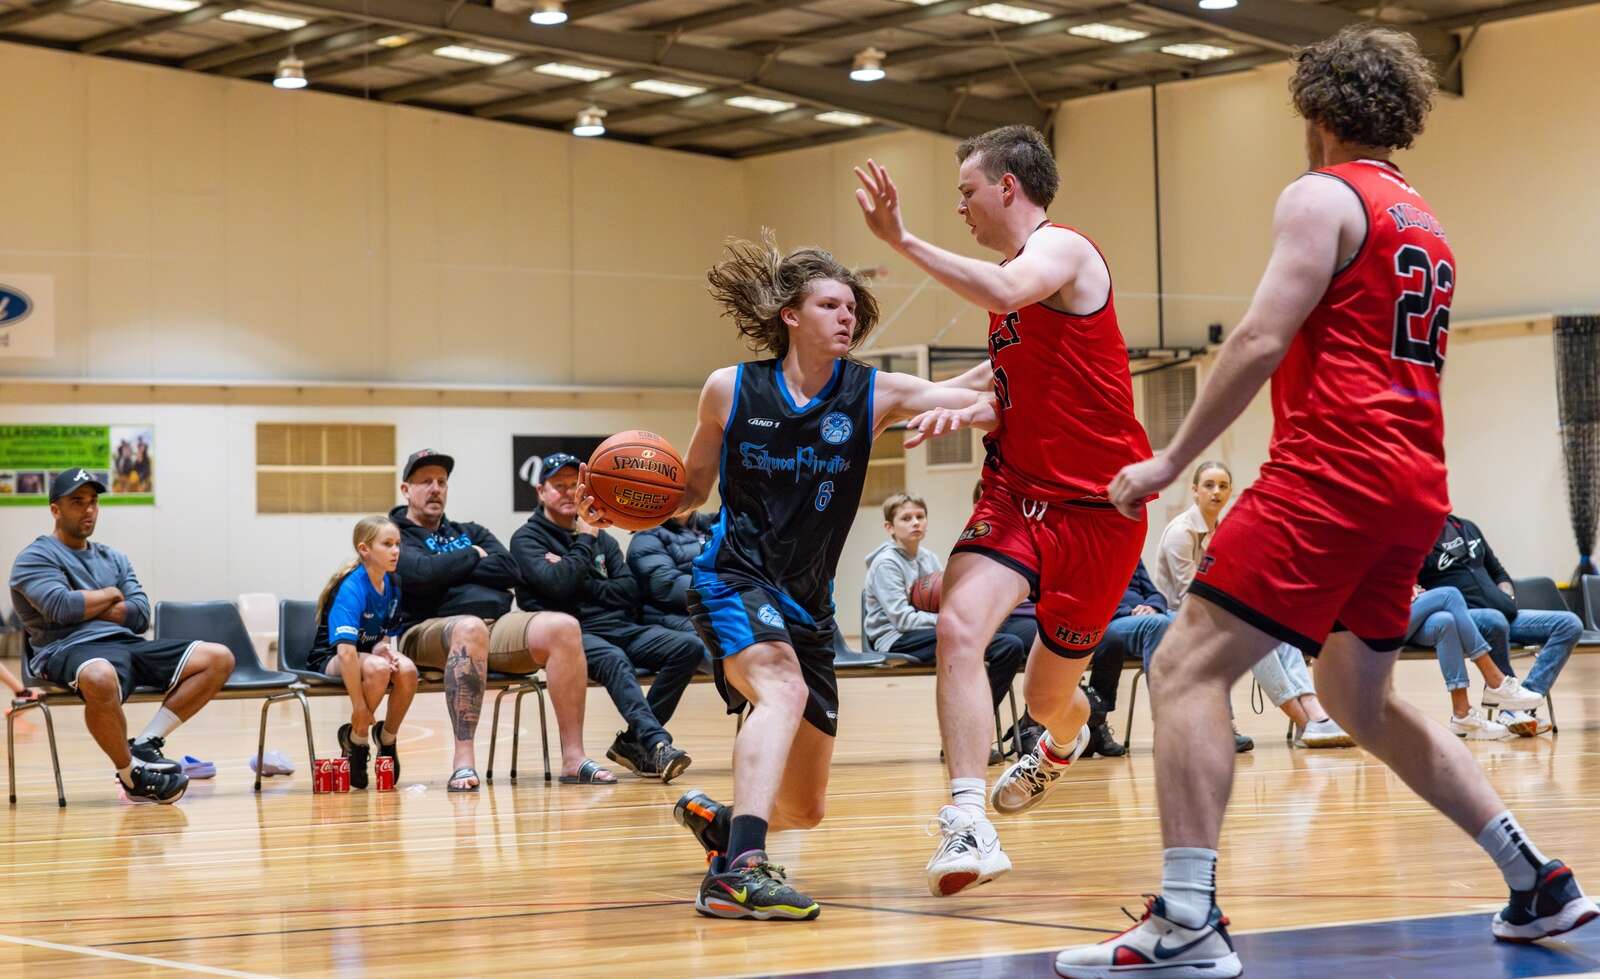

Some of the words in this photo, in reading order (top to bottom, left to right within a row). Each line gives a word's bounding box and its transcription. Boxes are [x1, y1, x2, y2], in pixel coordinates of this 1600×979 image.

[1391, 244, 1454, 376] 22
[611, 454, 678, 483] SPALDING
[613, 485, 670, 504] LEGACY
[814, 480, 834, 512] 6
[1056, 624, 1103, 645] HEAT
